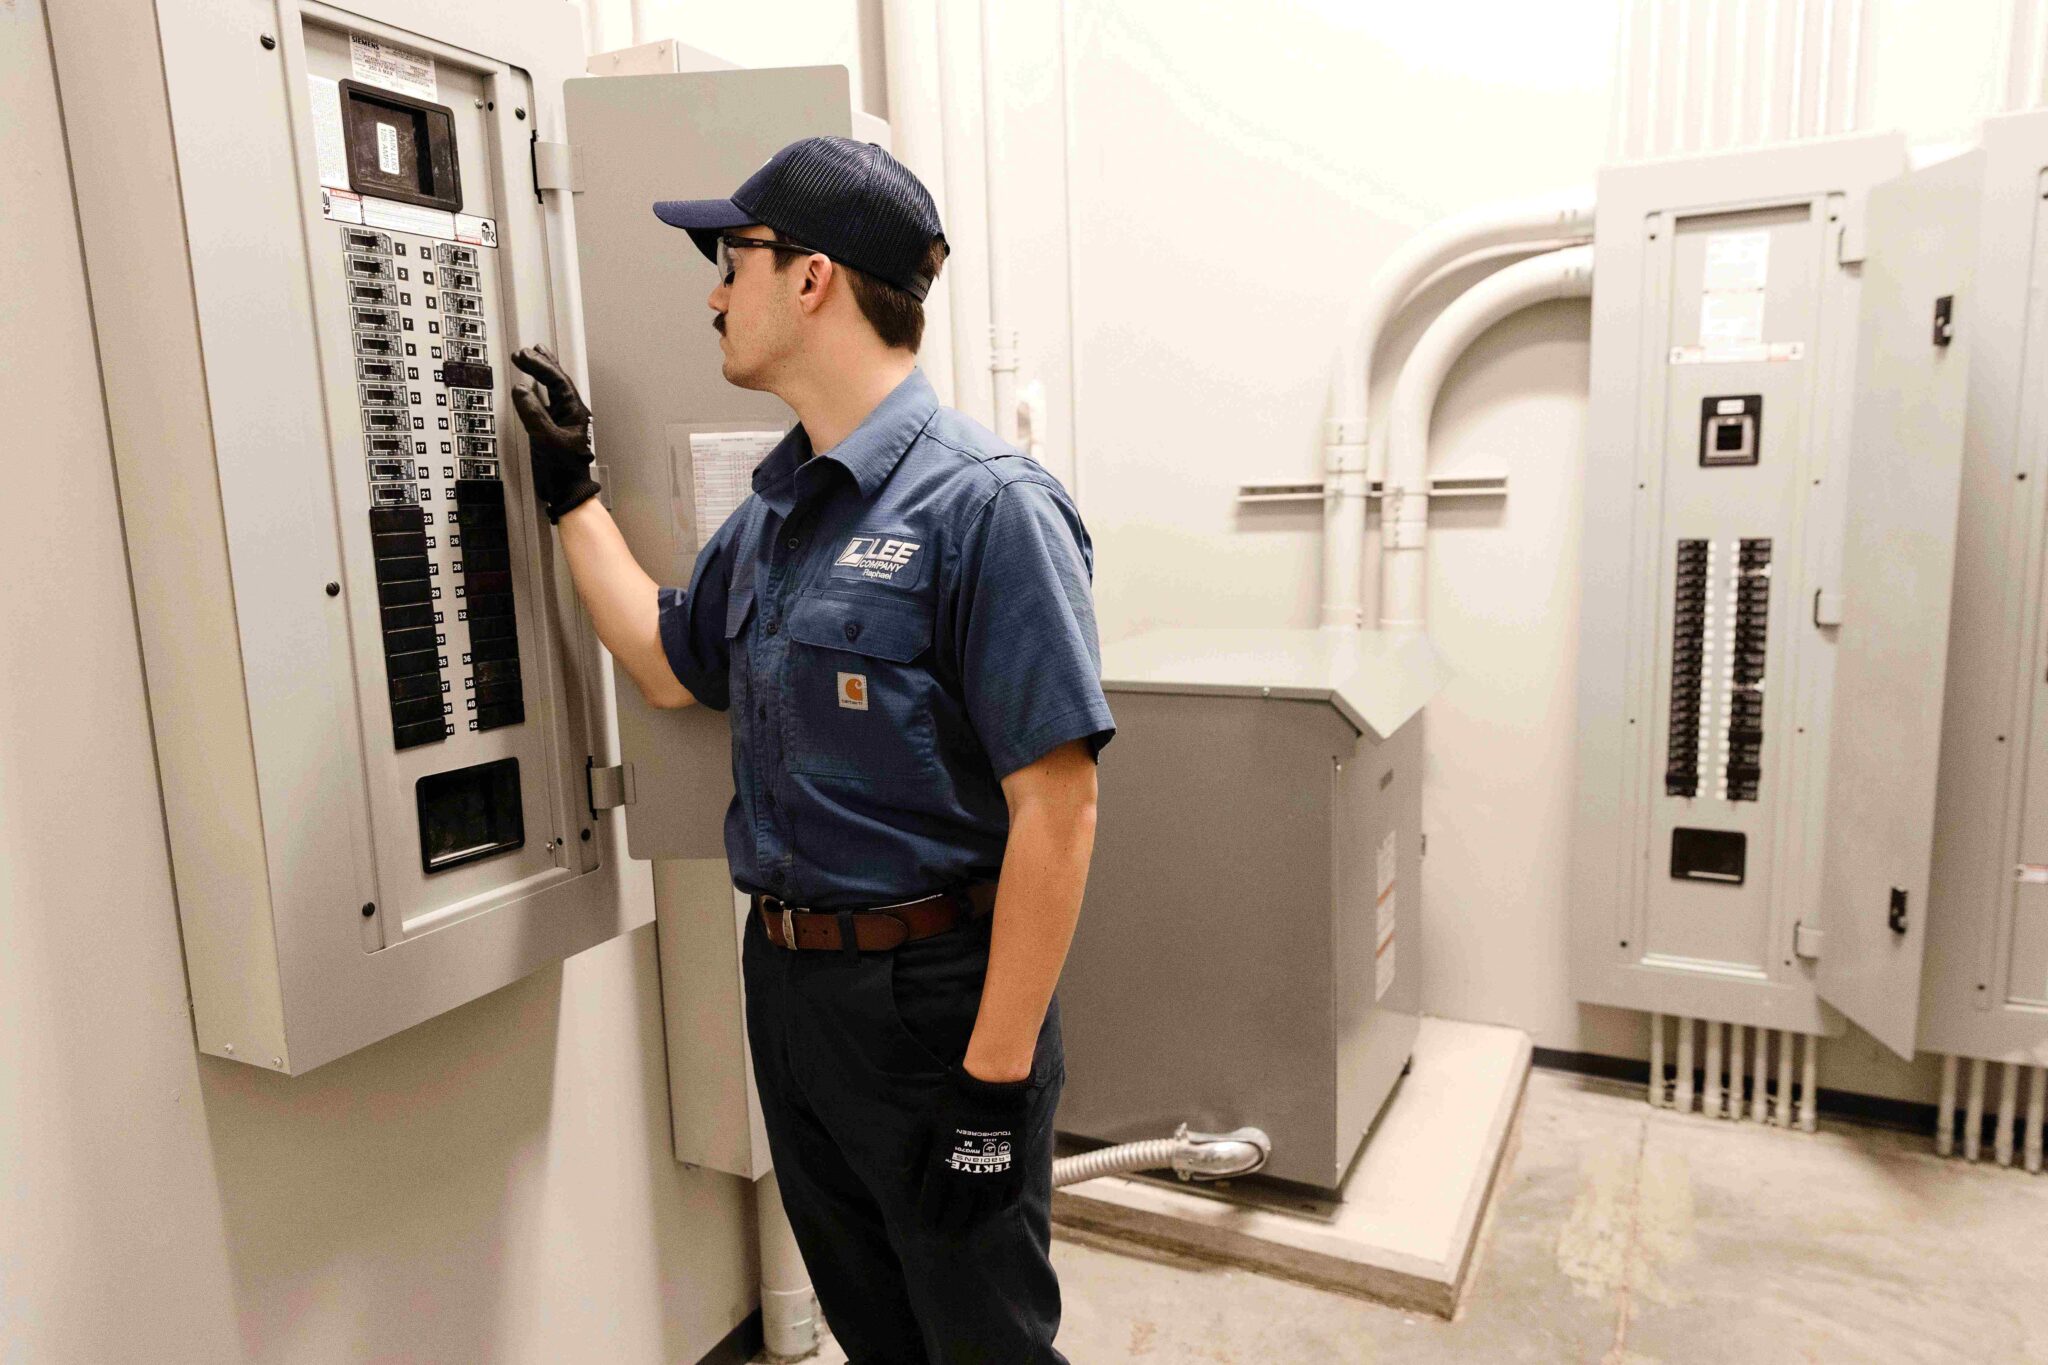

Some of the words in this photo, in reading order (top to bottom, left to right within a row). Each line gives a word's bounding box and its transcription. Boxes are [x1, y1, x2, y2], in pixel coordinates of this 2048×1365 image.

[352, 36, 380, 50] SIEMENS
[865, 538, 920, 564] LEE
[860, 560, 904, 572] COMPANY
[863, 568, 892, 580] Raphael
[956, 1128, 1011, 1136] TOUCHSCREEN
[951, 1161, 1010, 1174] TEKTYE
